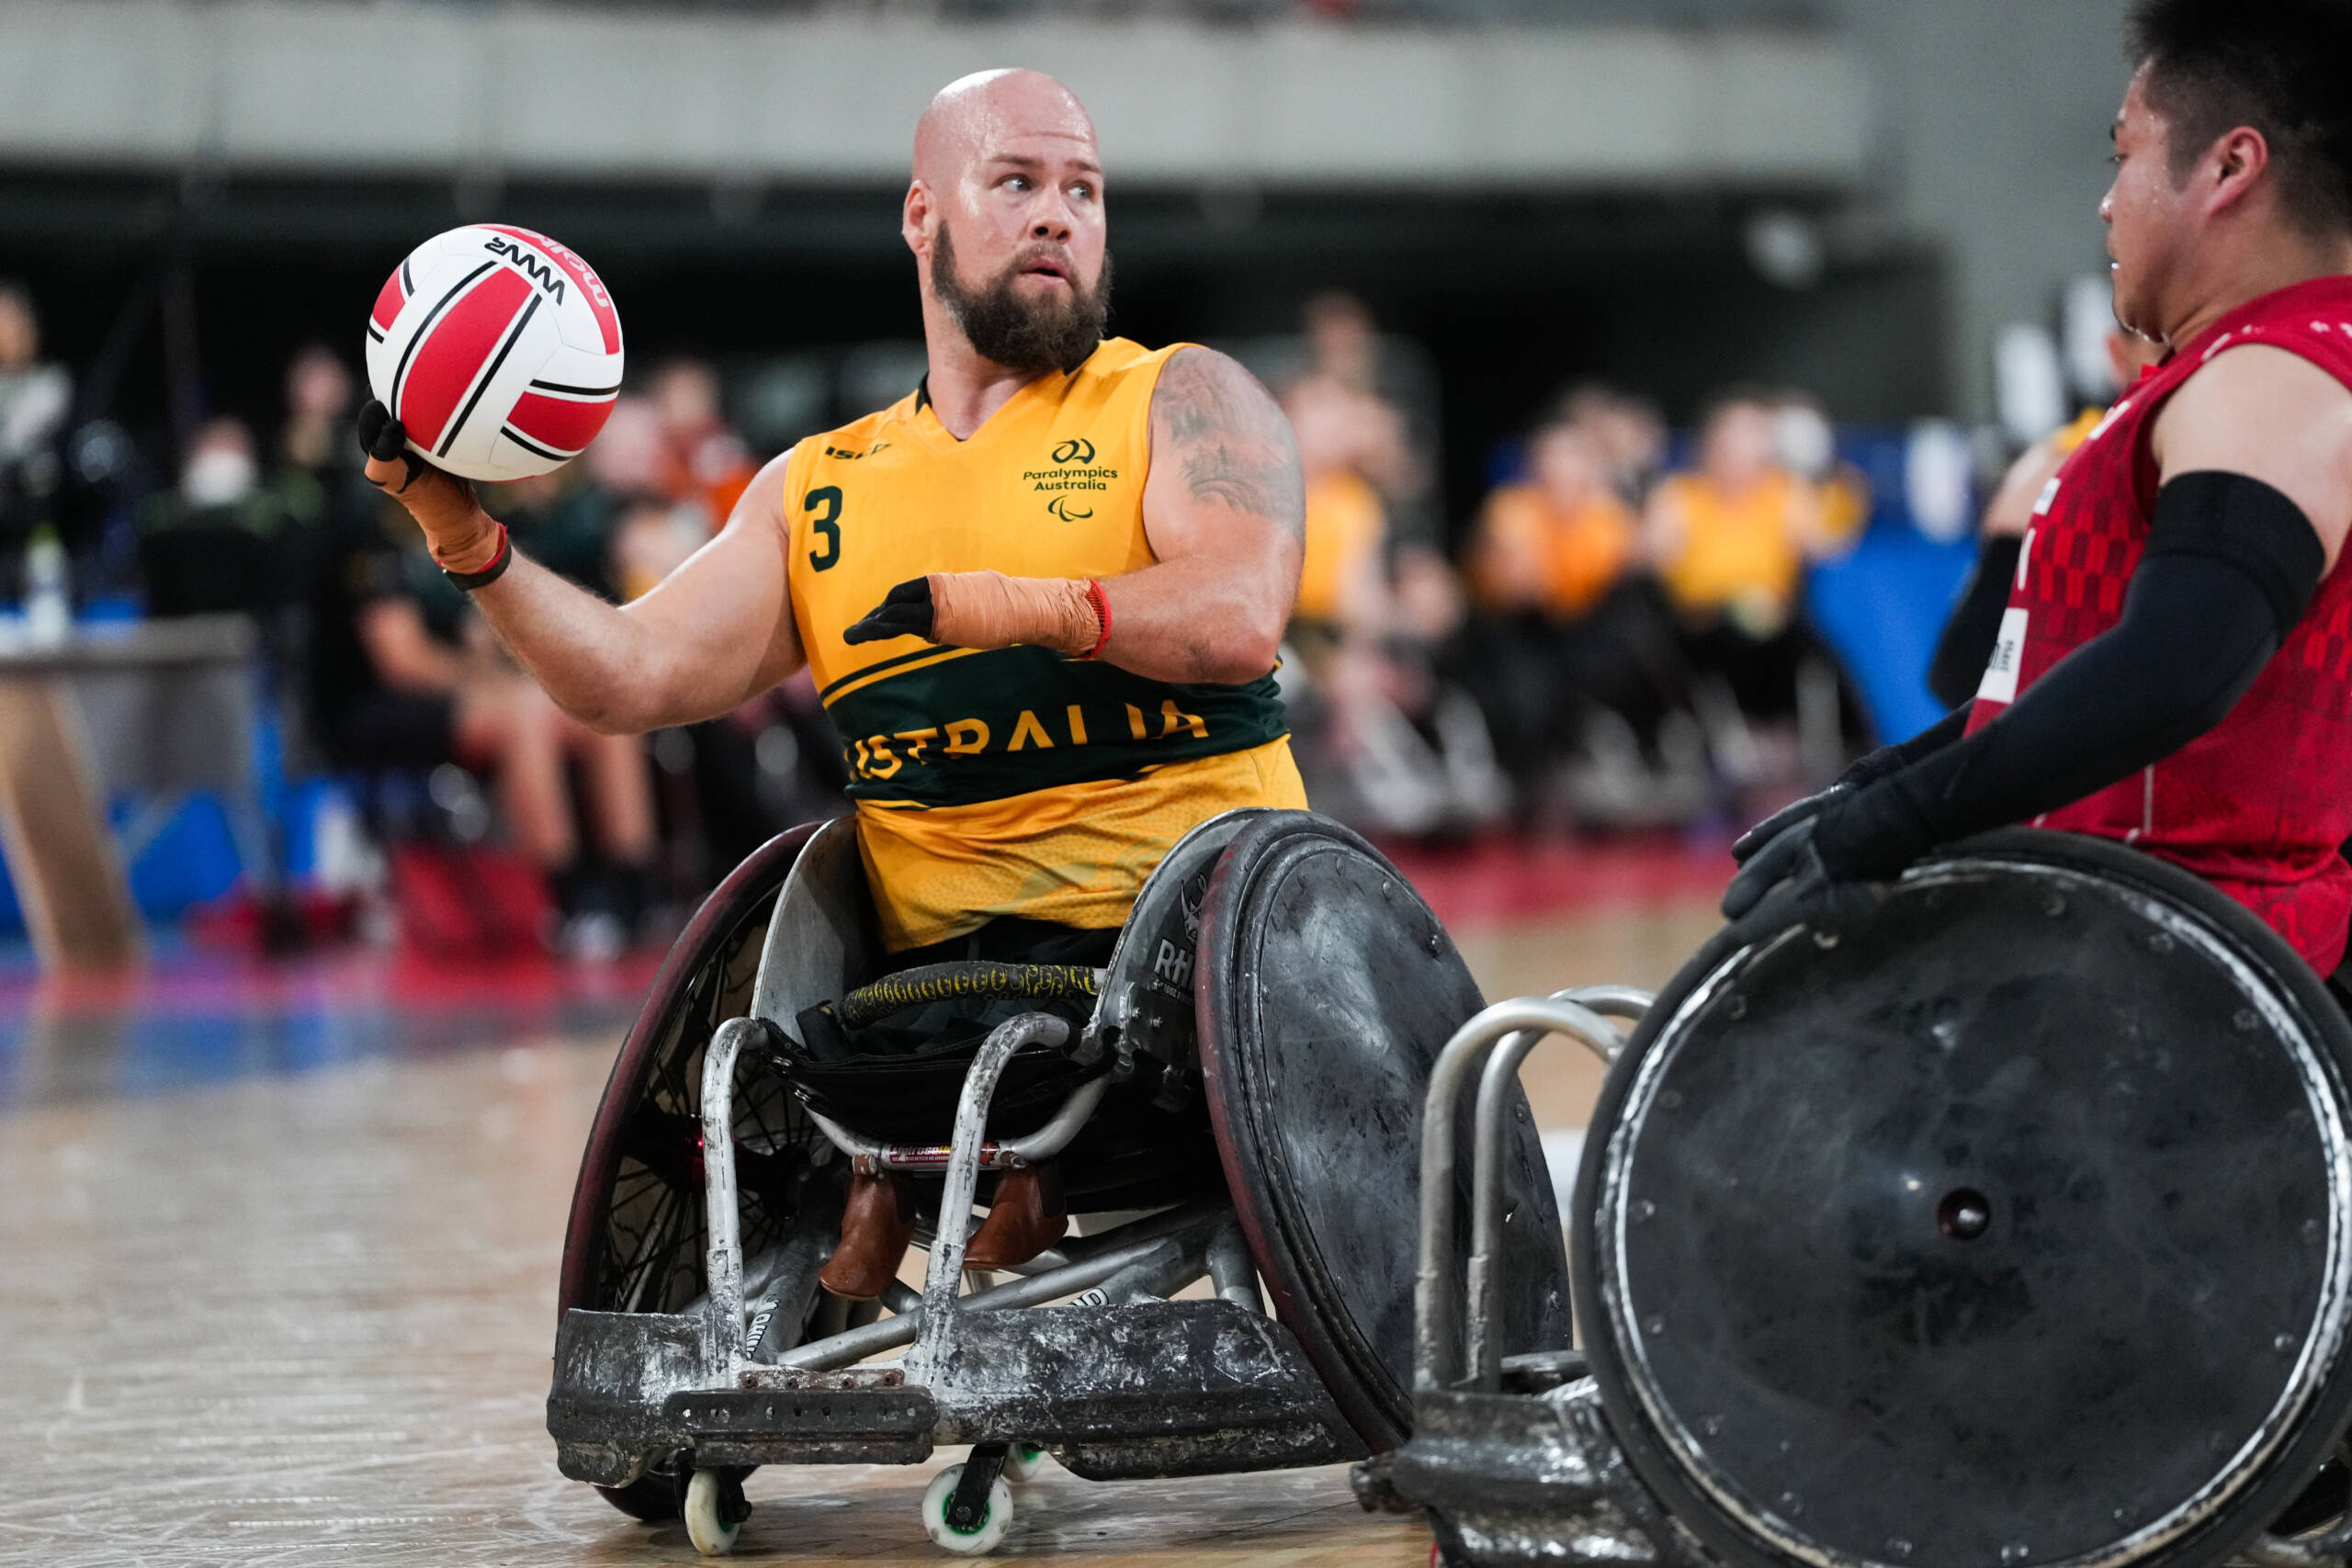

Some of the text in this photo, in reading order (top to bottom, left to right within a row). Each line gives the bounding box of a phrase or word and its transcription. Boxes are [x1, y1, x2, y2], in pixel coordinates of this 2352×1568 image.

[1023, 466, 1118, 480] Paralympics
[1034, 479, 1107, 491] Australia
[804, 485, 843, 573] 3
